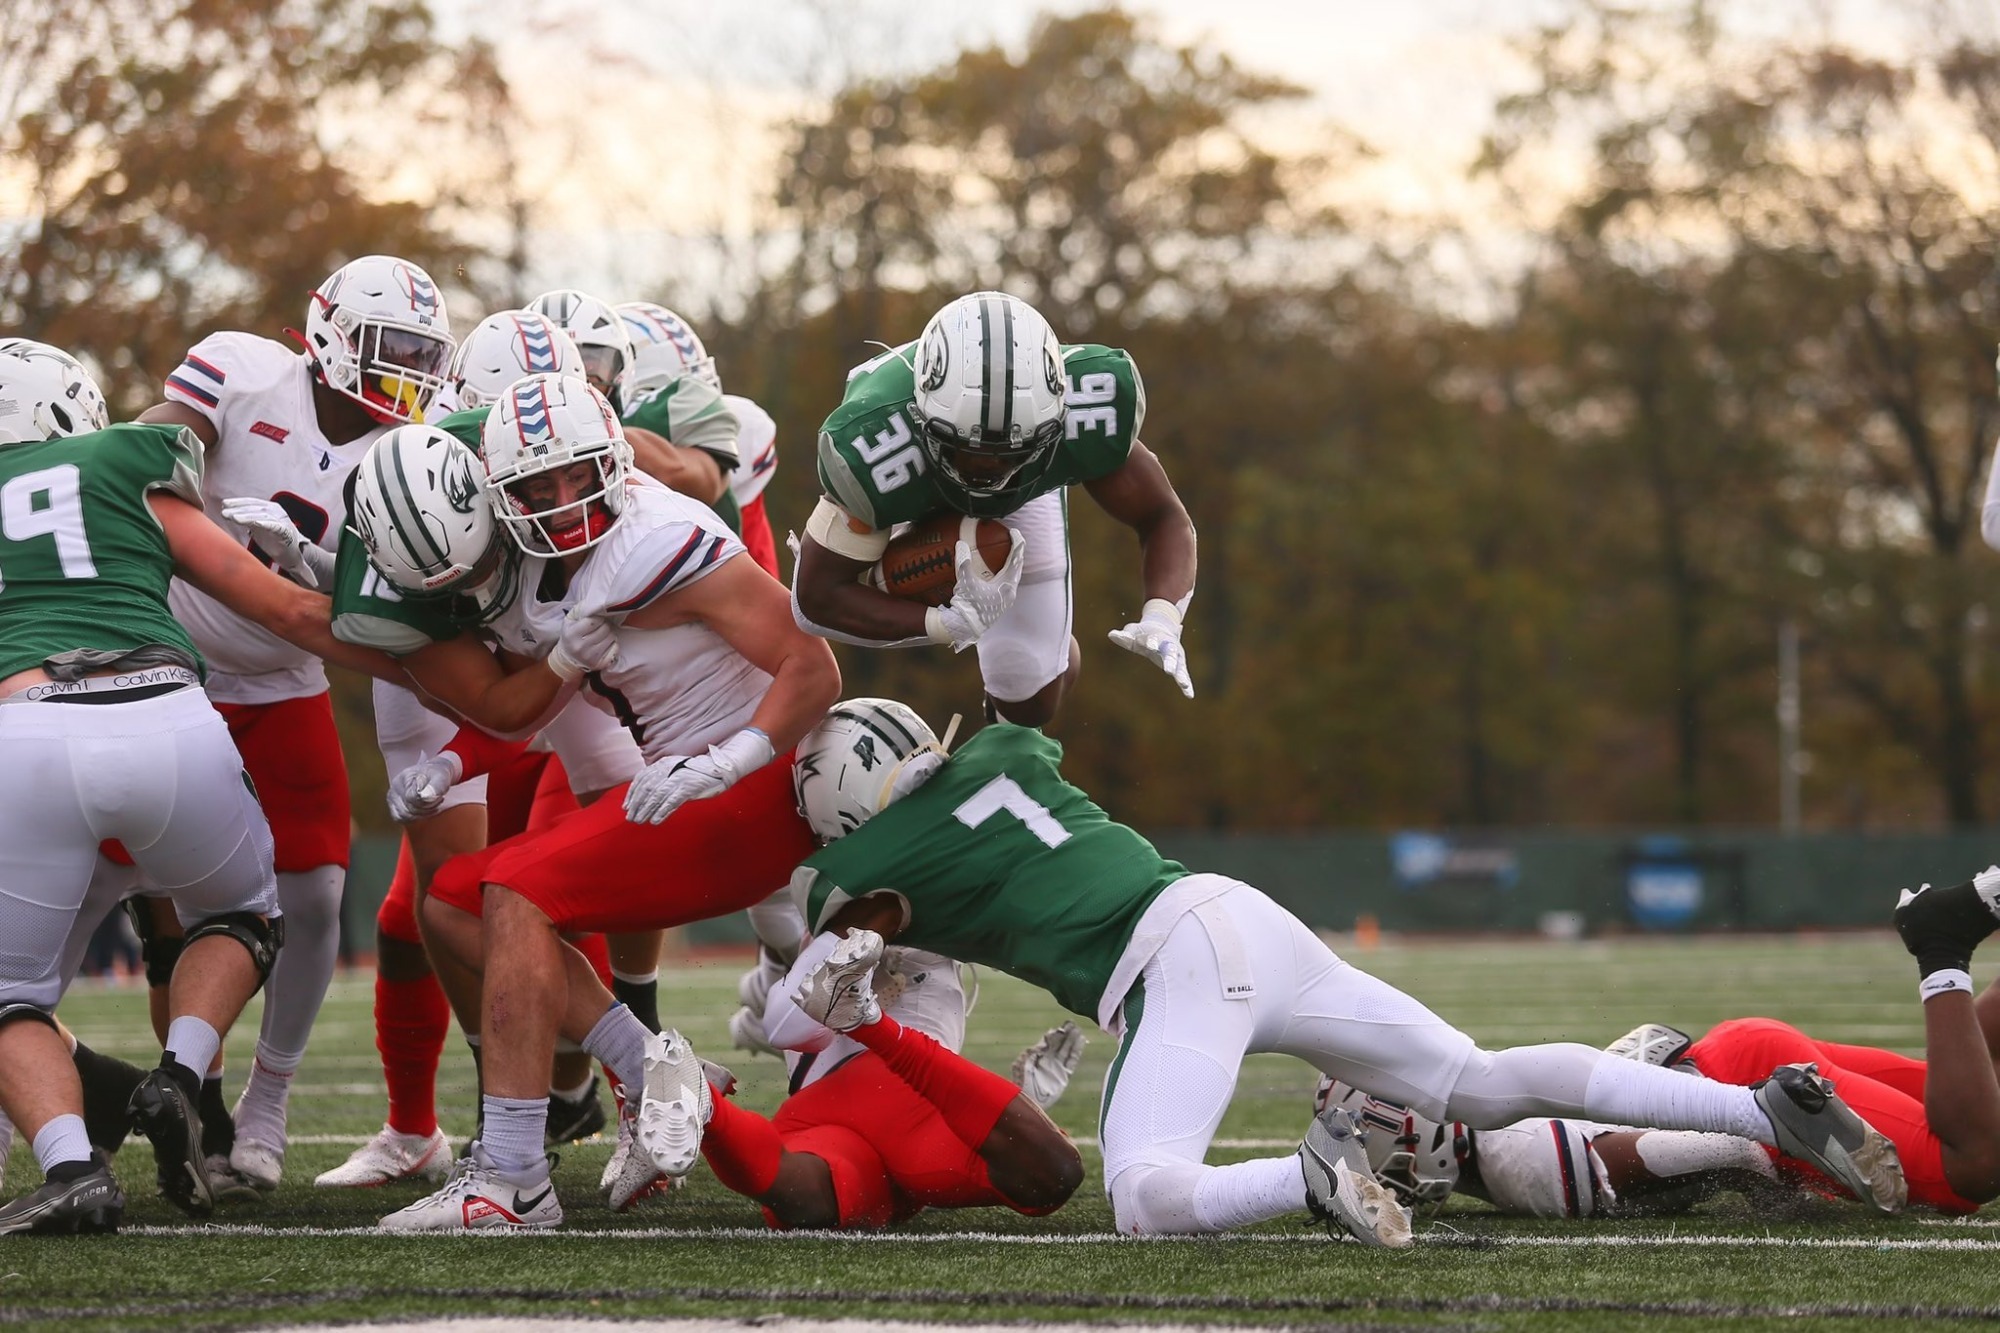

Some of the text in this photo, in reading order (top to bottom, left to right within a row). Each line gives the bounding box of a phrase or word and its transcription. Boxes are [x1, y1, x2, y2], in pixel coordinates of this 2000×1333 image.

[1064, 372, 1117, 440] 36
[851, 411, 927, 494] 36
[0, 463, 99, 595] 9
[425, 568, 461, 588] Riddell
[27, 681, 81, 701] Calvin
[114, 671, 168, 687] Calvin
[952, 772, 1073, 850] 7
